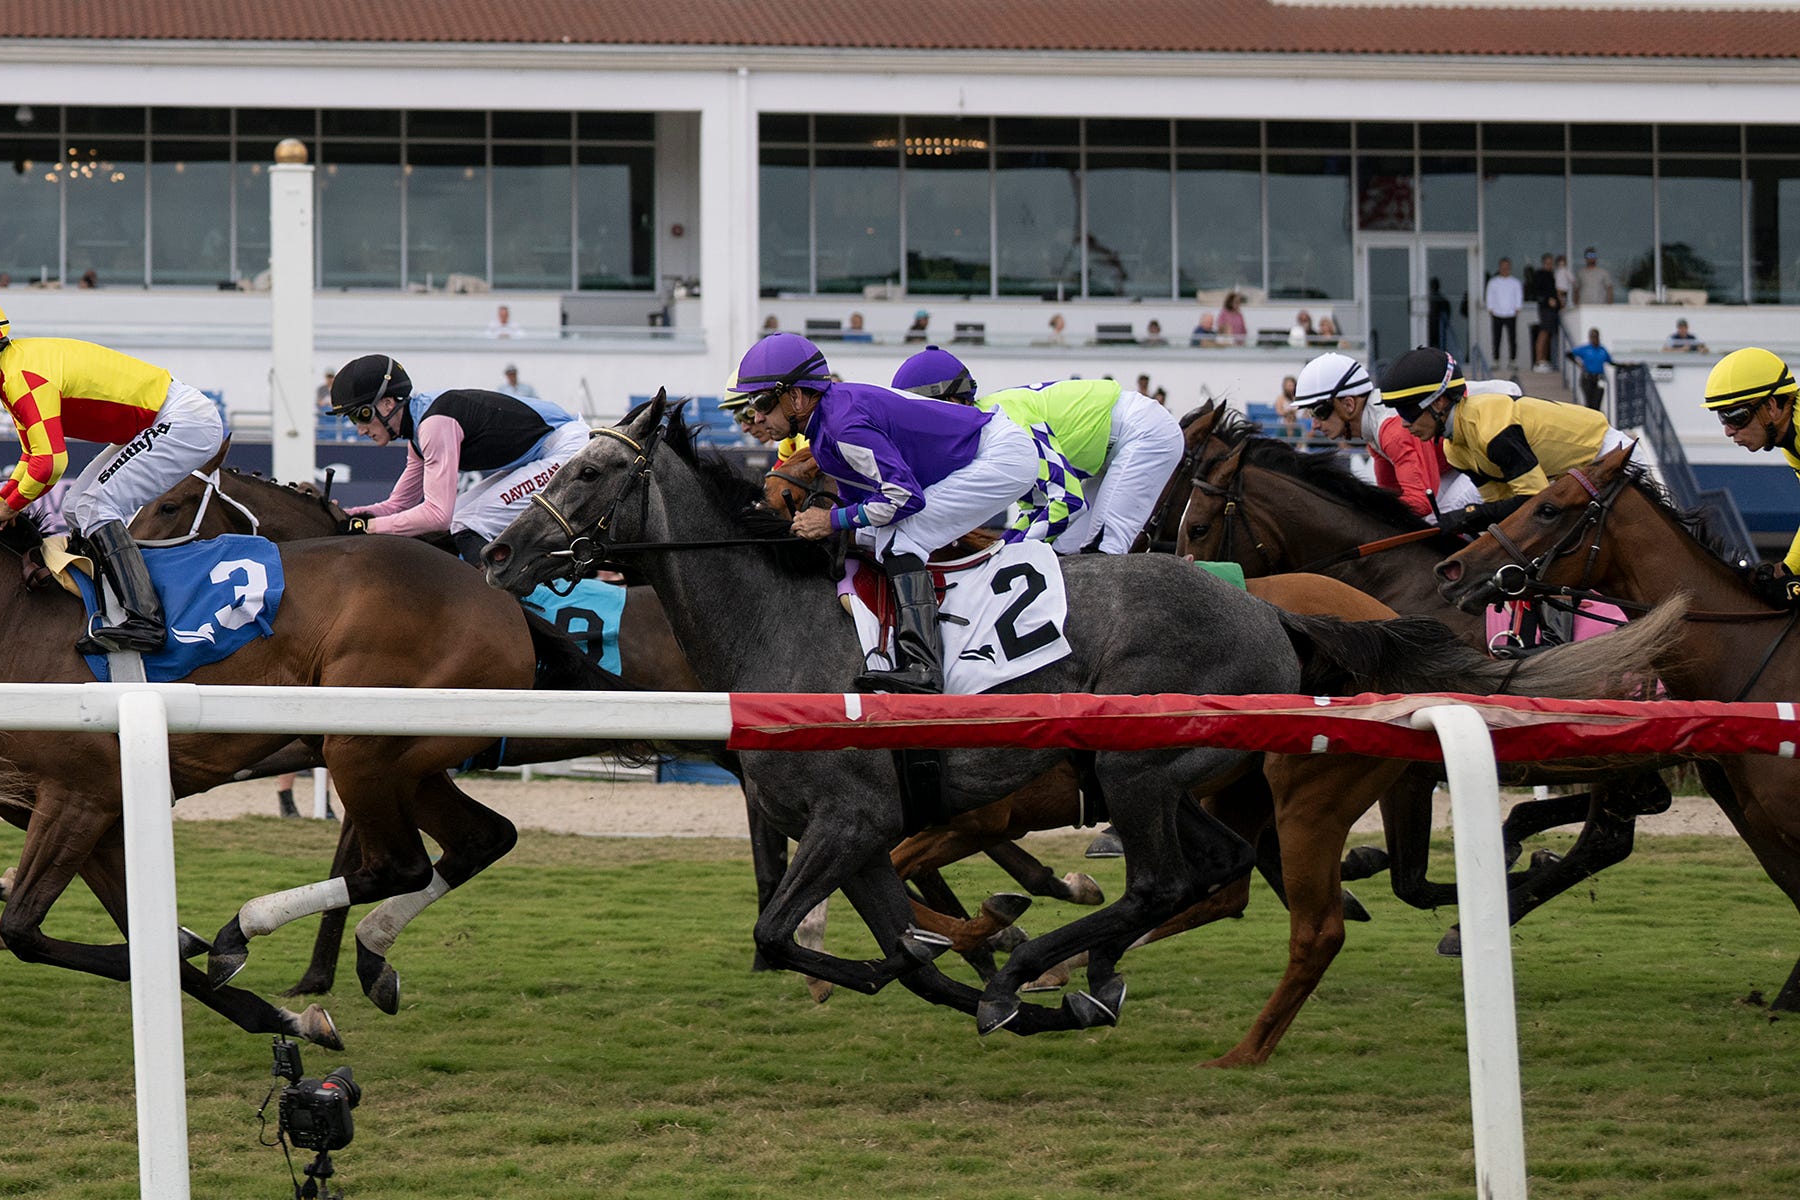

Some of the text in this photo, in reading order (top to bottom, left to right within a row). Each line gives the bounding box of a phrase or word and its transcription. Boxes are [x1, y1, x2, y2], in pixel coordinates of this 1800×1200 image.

[500, 479, 535, 505] DAVID
[209, 558, 269, 631] 3
[990, 562, 1061, 662] 2
